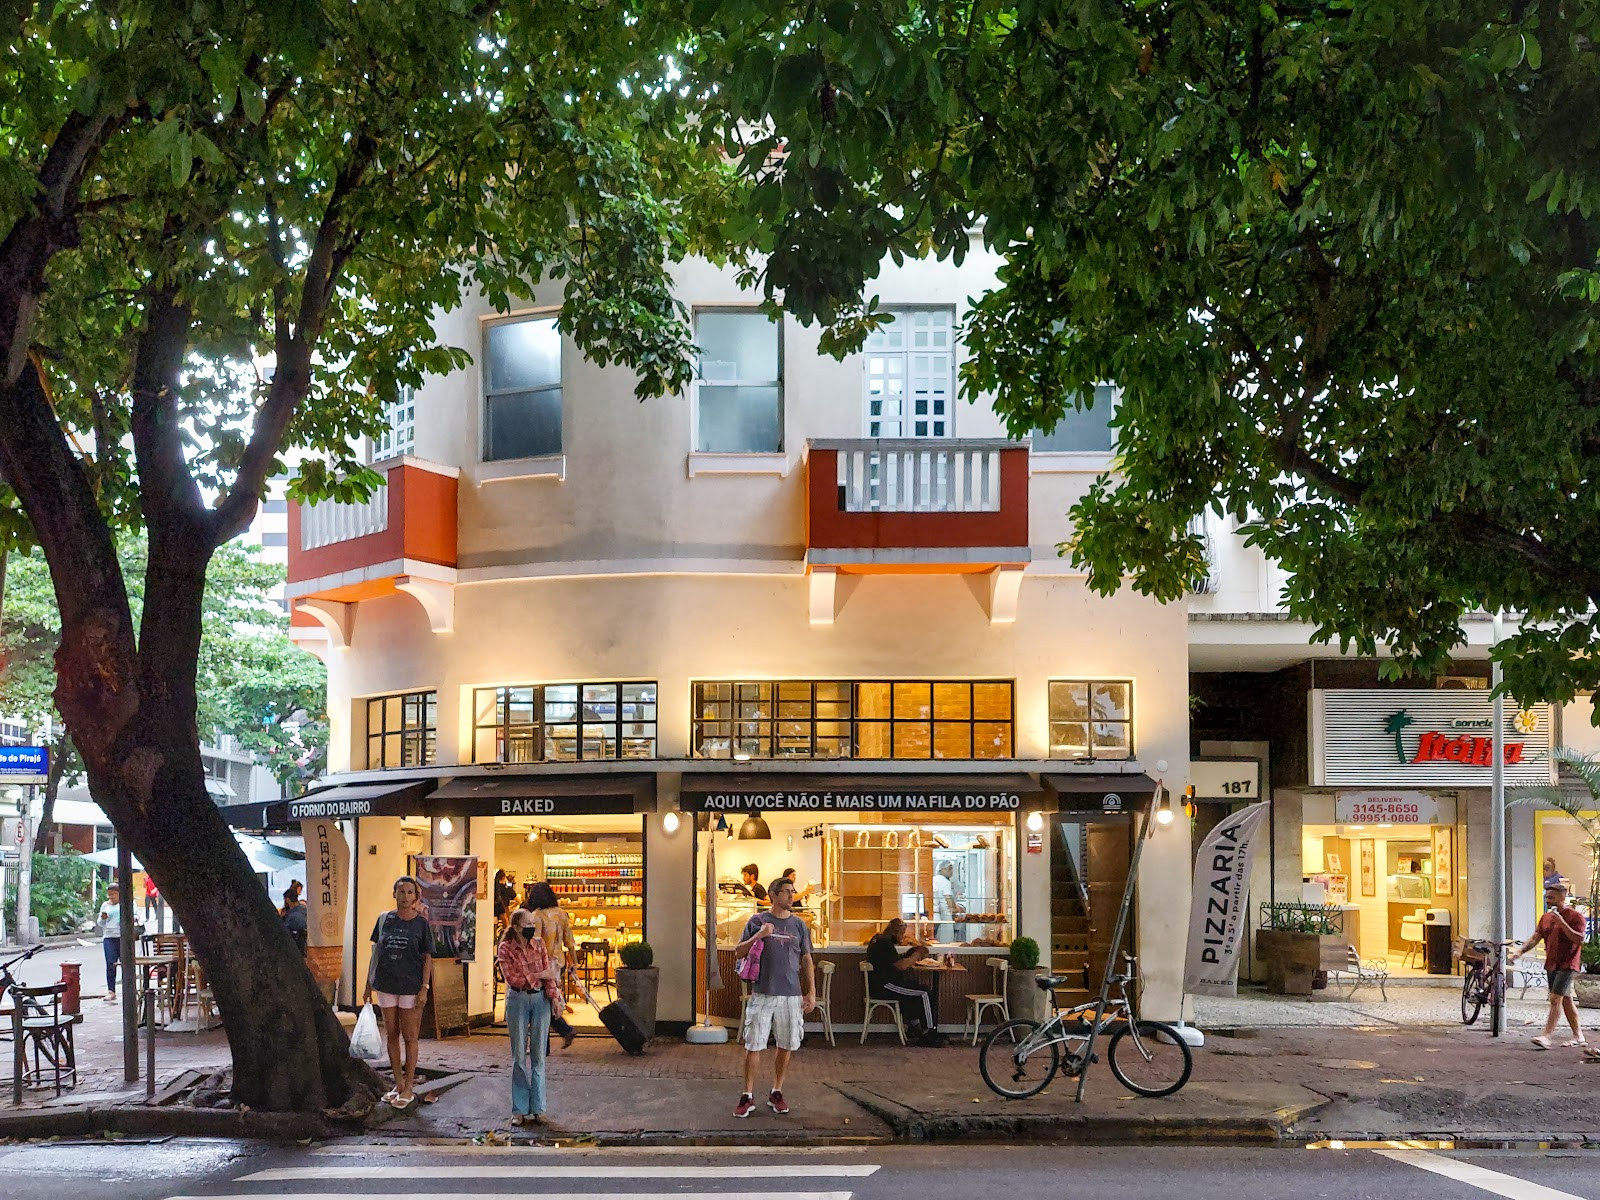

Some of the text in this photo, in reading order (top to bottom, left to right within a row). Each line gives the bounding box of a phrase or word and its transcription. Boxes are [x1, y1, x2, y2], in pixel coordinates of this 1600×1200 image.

[1222, 780, 1251, 794] 187
[292, 800, 371, 817] O FORNO DO BAIRRO
[501, 799, 555, 813] BAKED
[704, 792, 1020, 809] AQUI VOCÊ NÃO É MAIS UM NA FILA DO PÃO
[1353, 804, 1418, 813] 3145-8650
[1352, 814, 1419, 822] 99951-0860
[317, 824, 331, 906] BAKED
[1236, 864, 1245, 881] das
[1201, 823, 1242, 965] PIZZARIA
[1232, 882, 1241, 913] partir
